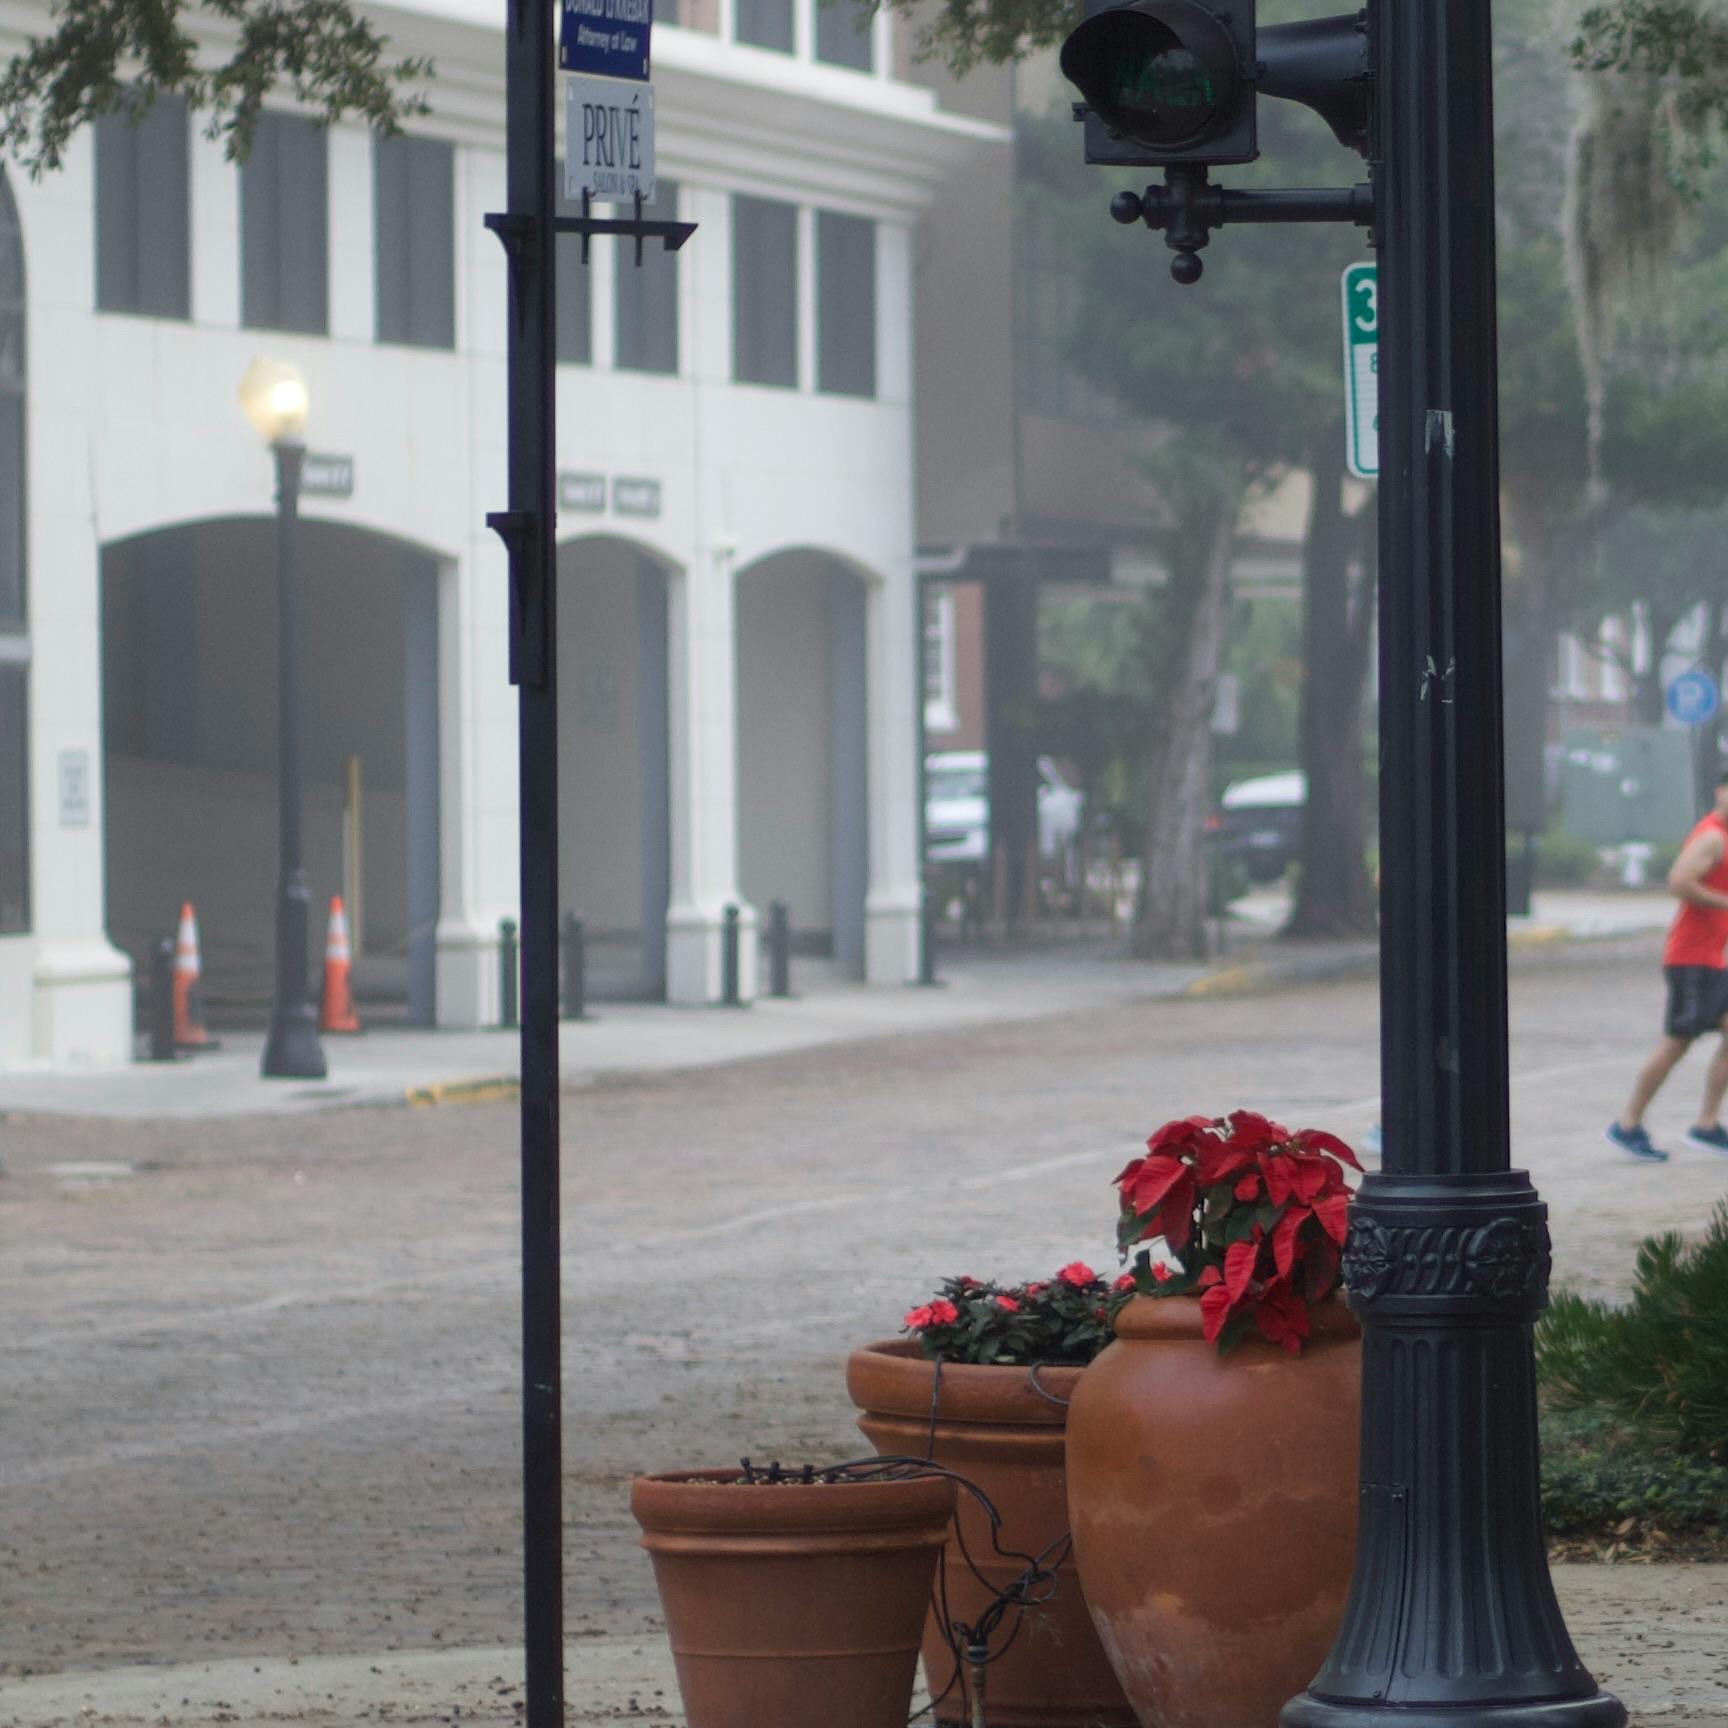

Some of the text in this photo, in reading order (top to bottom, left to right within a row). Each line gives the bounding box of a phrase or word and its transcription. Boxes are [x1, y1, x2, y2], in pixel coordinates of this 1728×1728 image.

[577, 23, 637, 54] Attorney at Law
[582, 93, 641, 170] PRIVÉ
